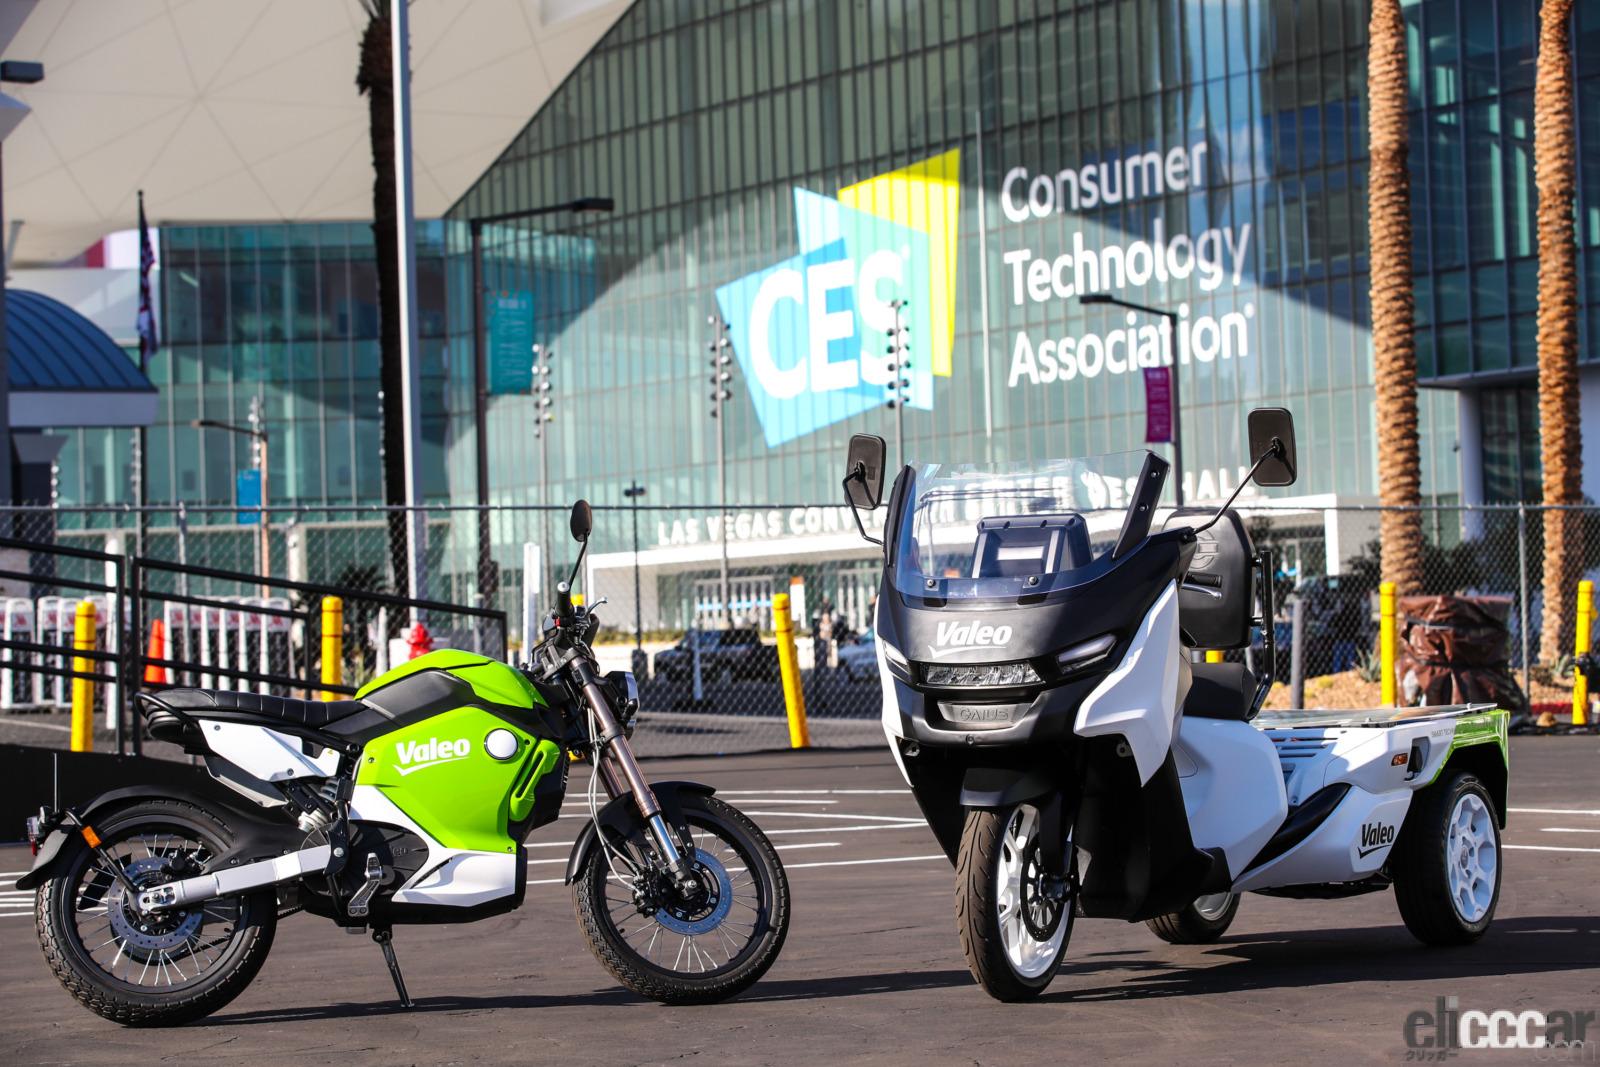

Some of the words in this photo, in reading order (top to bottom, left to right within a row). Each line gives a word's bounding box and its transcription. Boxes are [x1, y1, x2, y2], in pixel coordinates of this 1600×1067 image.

[1001, 141, 1207, 222] Consumer
[1003, 218, 1251, 305] Technology
[657, 518, 700, 546] LAS
[706, 510, 783, 542] VEGAS
[936, 620, 1013, 646] Valeo
[395, 737, 471, 765] Valeo
[1361, 822, 1395, 848] Valeo
